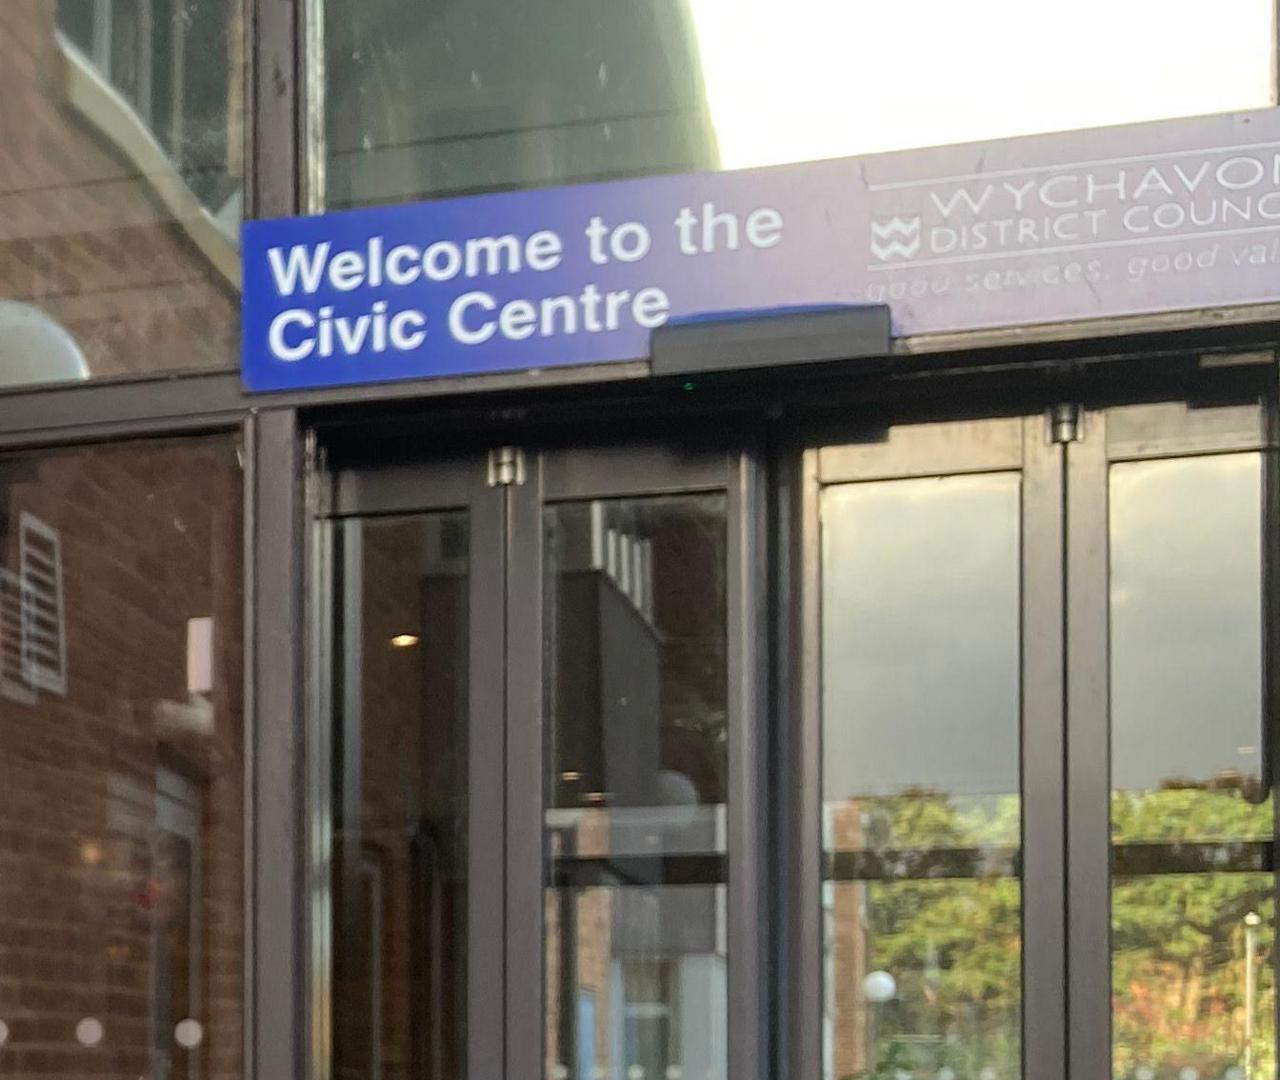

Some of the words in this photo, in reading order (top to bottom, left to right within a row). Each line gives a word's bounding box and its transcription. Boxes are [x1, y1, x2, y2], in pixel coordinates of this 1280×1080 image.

[930, 153, 1280, 217] WYCHAVO
[267, 230, 563, 296] Welcome
[585, 216, 652, 264] to
[674, 201, 784, 256] the
[930, 207, 1107, 253] DISTRICT
[1127, 244, 1219, 282] good
[268, 300, 427, 362] Civic
[448, 284, 671, 345] Centre
